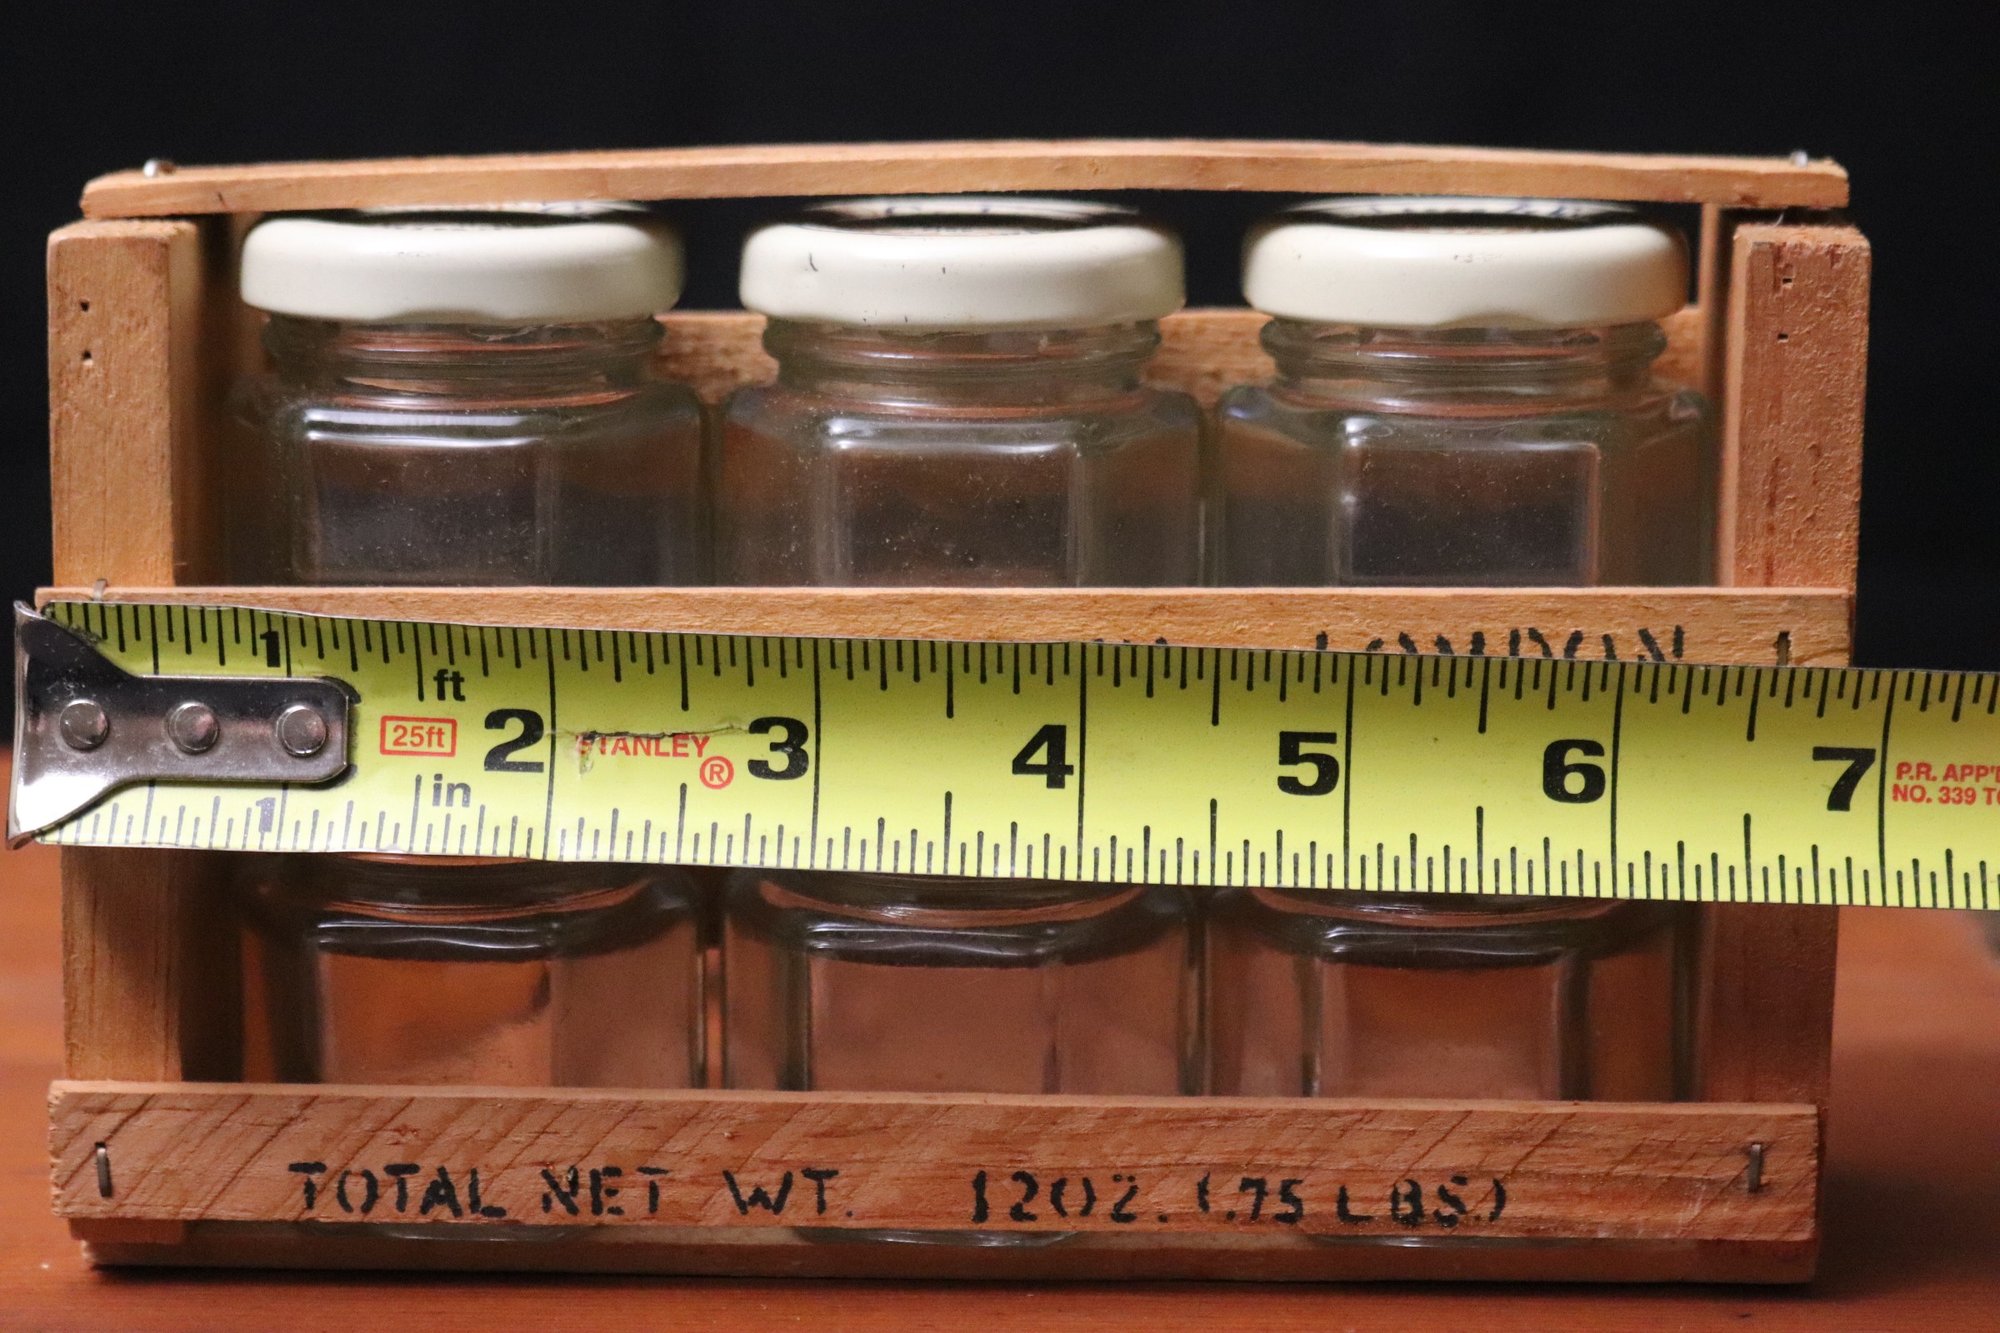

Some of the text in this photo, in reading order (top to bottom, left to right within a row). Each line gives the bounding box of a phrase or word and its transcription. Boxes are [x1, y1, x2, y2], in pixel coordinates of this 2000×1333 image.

[260, 631, 280, 668] 1
[433, 669, 466, 702] ft
[392, 724, 445, 748] 25ft
[484, 708, 544, 773] 2
[747, 716, 809, 780] 3
[1011, 724, 1074, 789] 4
[1276, 731, 1340, 796] 5
[1542, 739, 1605, 803] 6
[1811, 747, 1876, 811] 7
[1896, 761, 2000, 783] P.R. APP'
[432, 773, 471, 807] in
[1892, 783, 2000, 805] NO. 339 T
[256, 797, 276, 833] 1
[288, 1162, 506, 1217] TOTAL
[540, 1165, 669, 1216] NET
[722, 1168, 855, 1217] WT.
